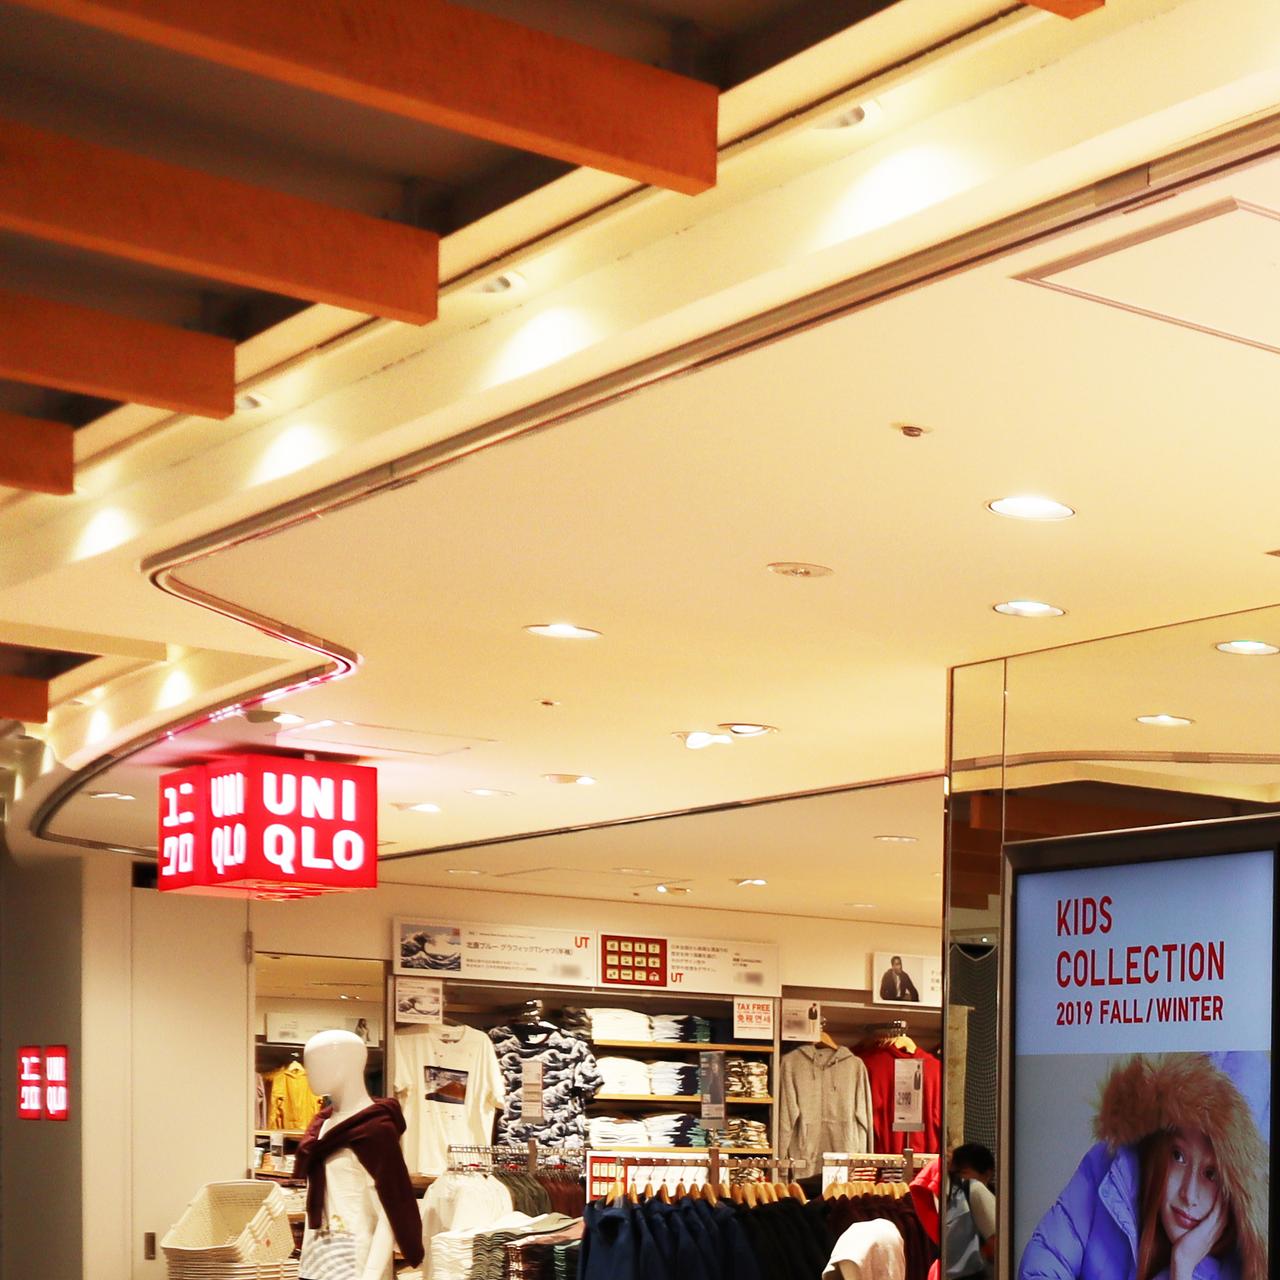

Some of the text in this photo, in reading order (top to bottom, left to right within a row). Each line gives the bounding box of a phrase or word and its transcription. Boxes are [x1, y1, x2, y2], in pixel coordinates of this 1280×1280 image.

[163, 782, 195, 827] ユニ
[211, 772, 244, 818] UNI
[263, 771, 356, 821] UNI
[162, 832, 194, 876] クロ
[211, 823, 246, 875] QLO
[263, 823, 365, 875] QLO
[1057, 896, 1113, 936] KIDS
[574, 936, 590, 948] UT
[671, 973, 684, 983] UT
[1056, 941, 1225, 988] COLLECTION
[737, 1002, 771, 1012] TAX FREE
[1056, 1001, 1093, 1025] 2019
[21, 1056, 41, 1080] ユニ
[20, 1086, 41, 1110] クロ
